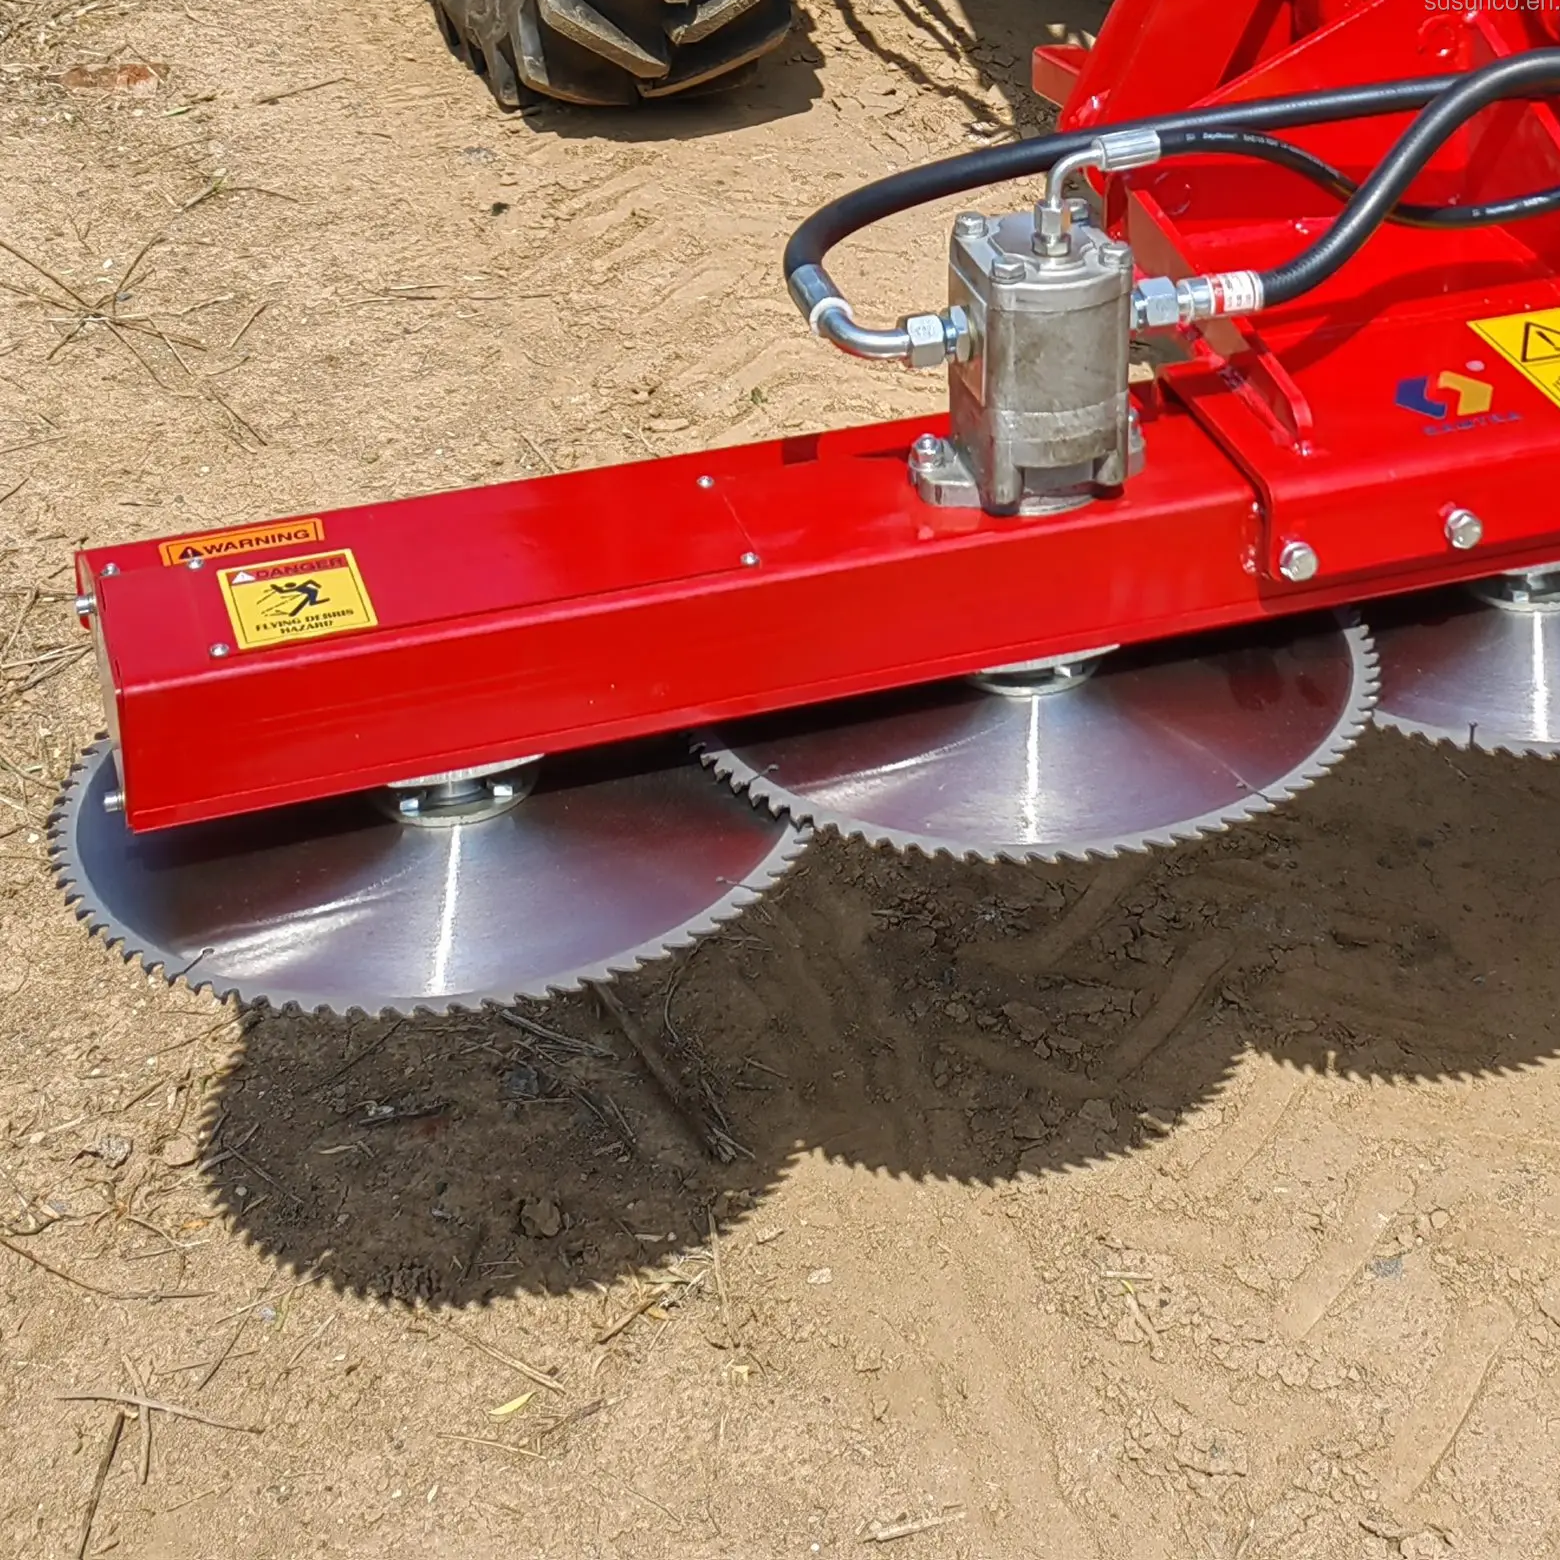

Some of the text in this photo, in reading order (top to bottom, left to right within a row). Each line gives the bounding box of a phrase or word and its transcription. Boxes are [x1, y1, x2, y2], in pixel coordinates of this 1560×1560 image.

[203, 529, 310, 556] WARNING
[256, 558, 343, 579] DANGER
[255, 608, 355, 632] FLYING DEBRIS
[280, 620, 334, 635] HAZARD
